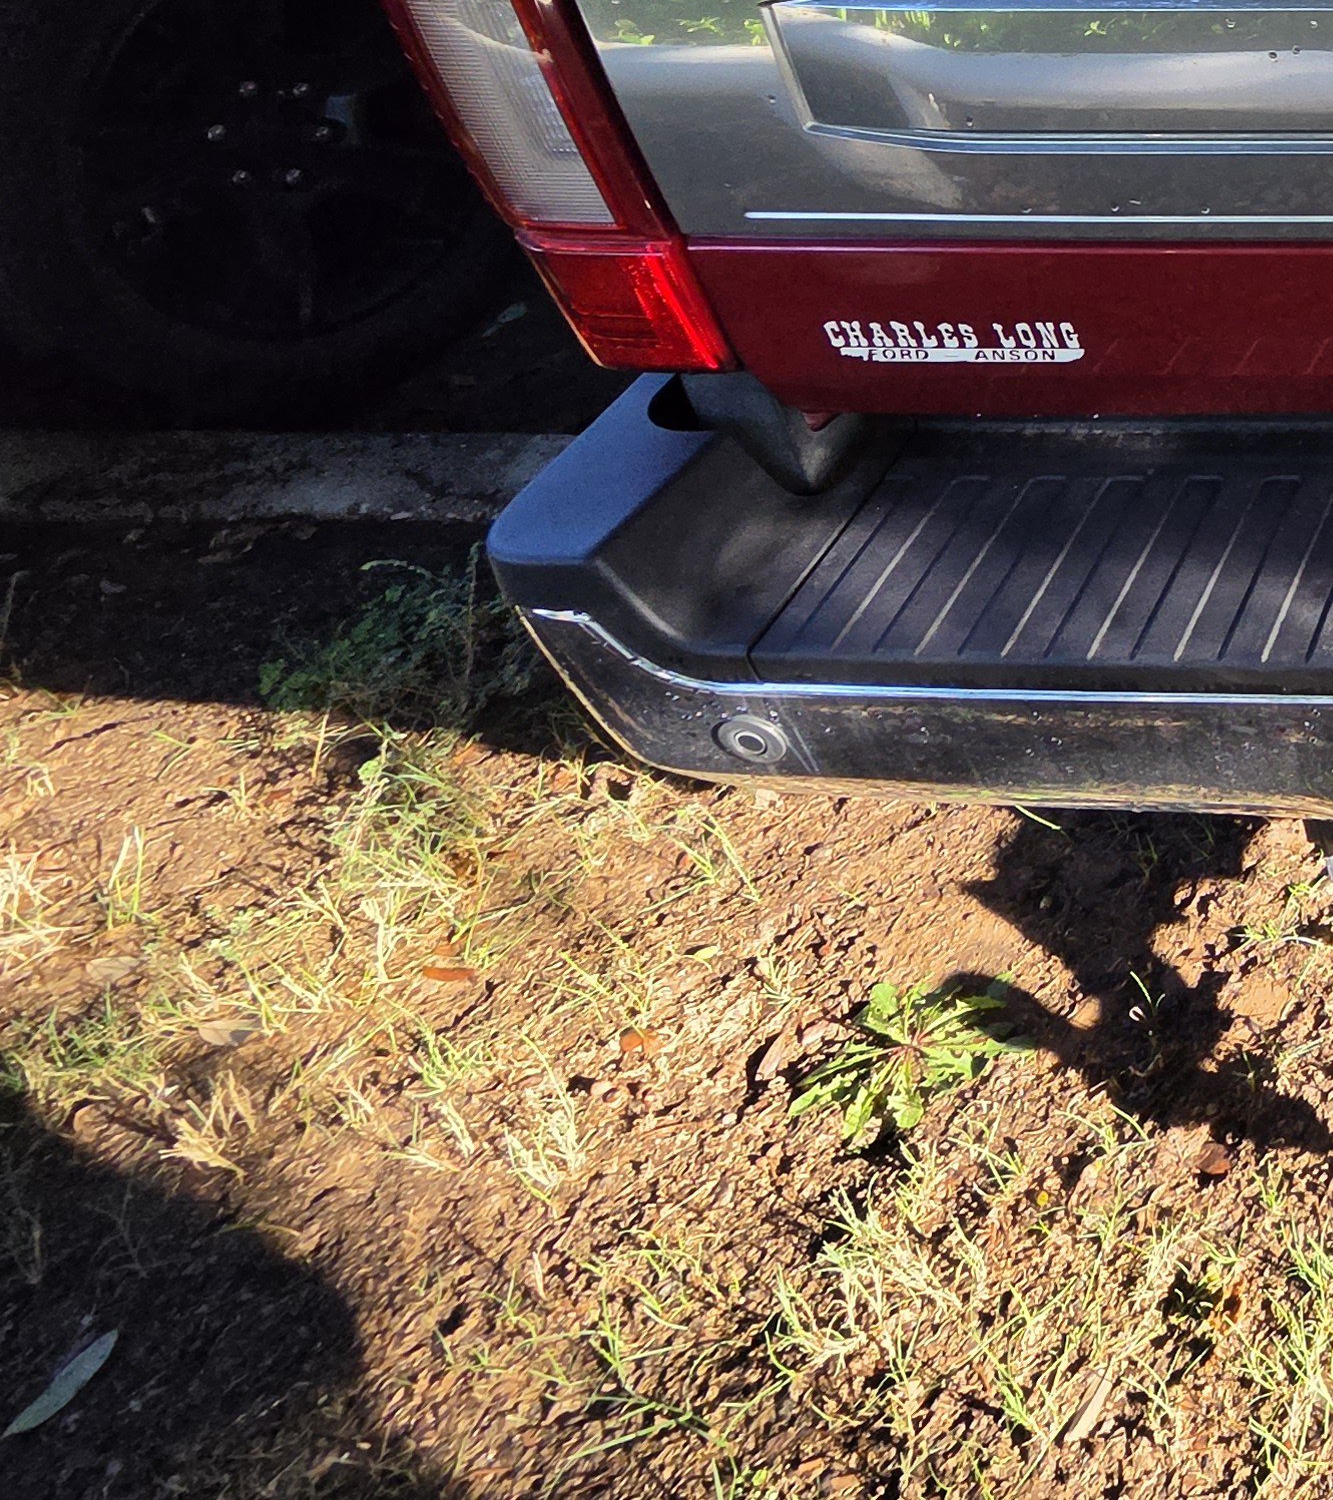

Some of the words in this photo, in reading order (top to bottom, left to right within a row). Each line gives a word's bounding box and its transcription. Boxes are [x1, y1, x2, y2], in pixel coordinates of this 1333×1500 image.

[823, 320, 979, 349] CHARLES
[992, 322, 1081, 349] LONG
[868, 349, 930, 361] FORD
[974, 349, 1057, 361] ANSON
